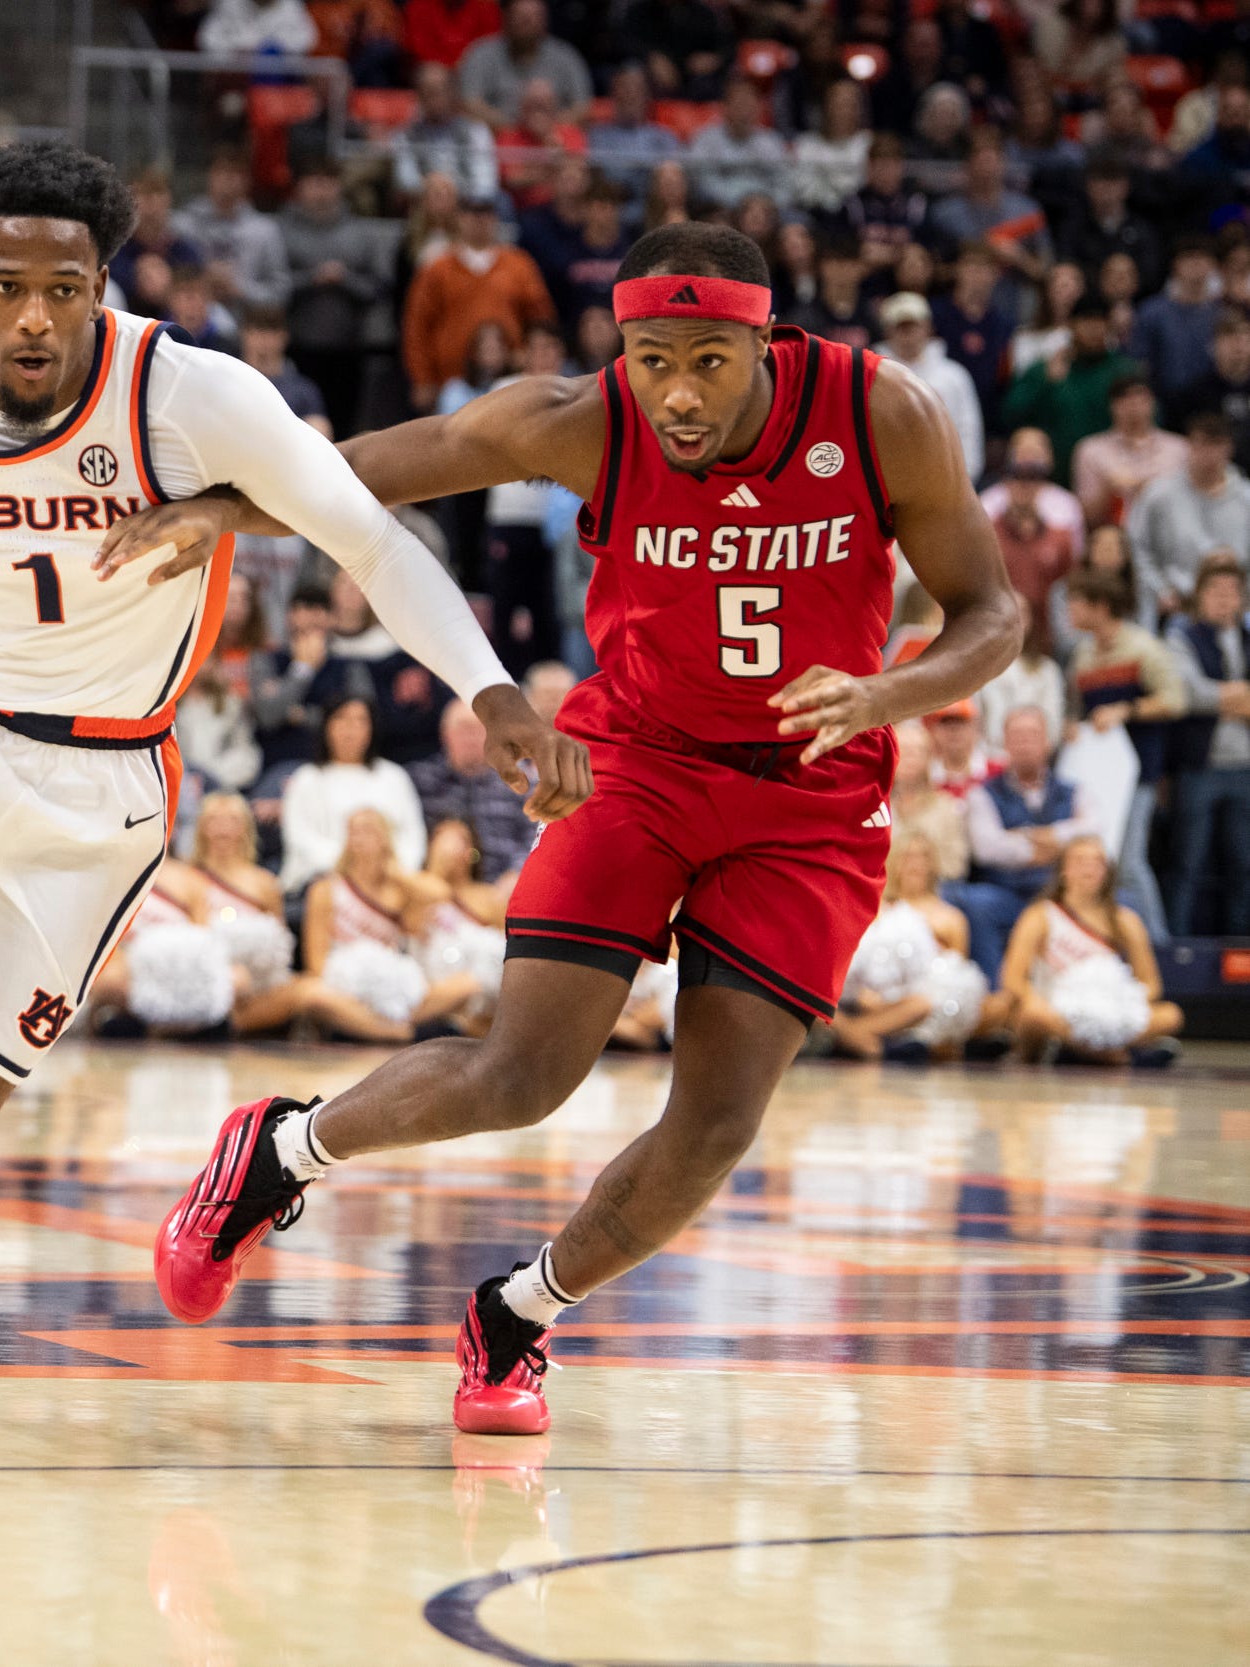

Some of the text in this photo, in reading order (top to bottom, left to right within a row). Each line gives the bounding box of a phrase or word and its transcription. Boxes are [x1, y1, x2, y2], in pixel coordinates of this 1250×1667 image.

[81, 446, 117, 485] SEC
[813, 452, 839, 462] ACC
[635, 514, 856, 572] NC STATE
[11, 553, 65, 624] 1
[716, 585, 782, 678] 5
